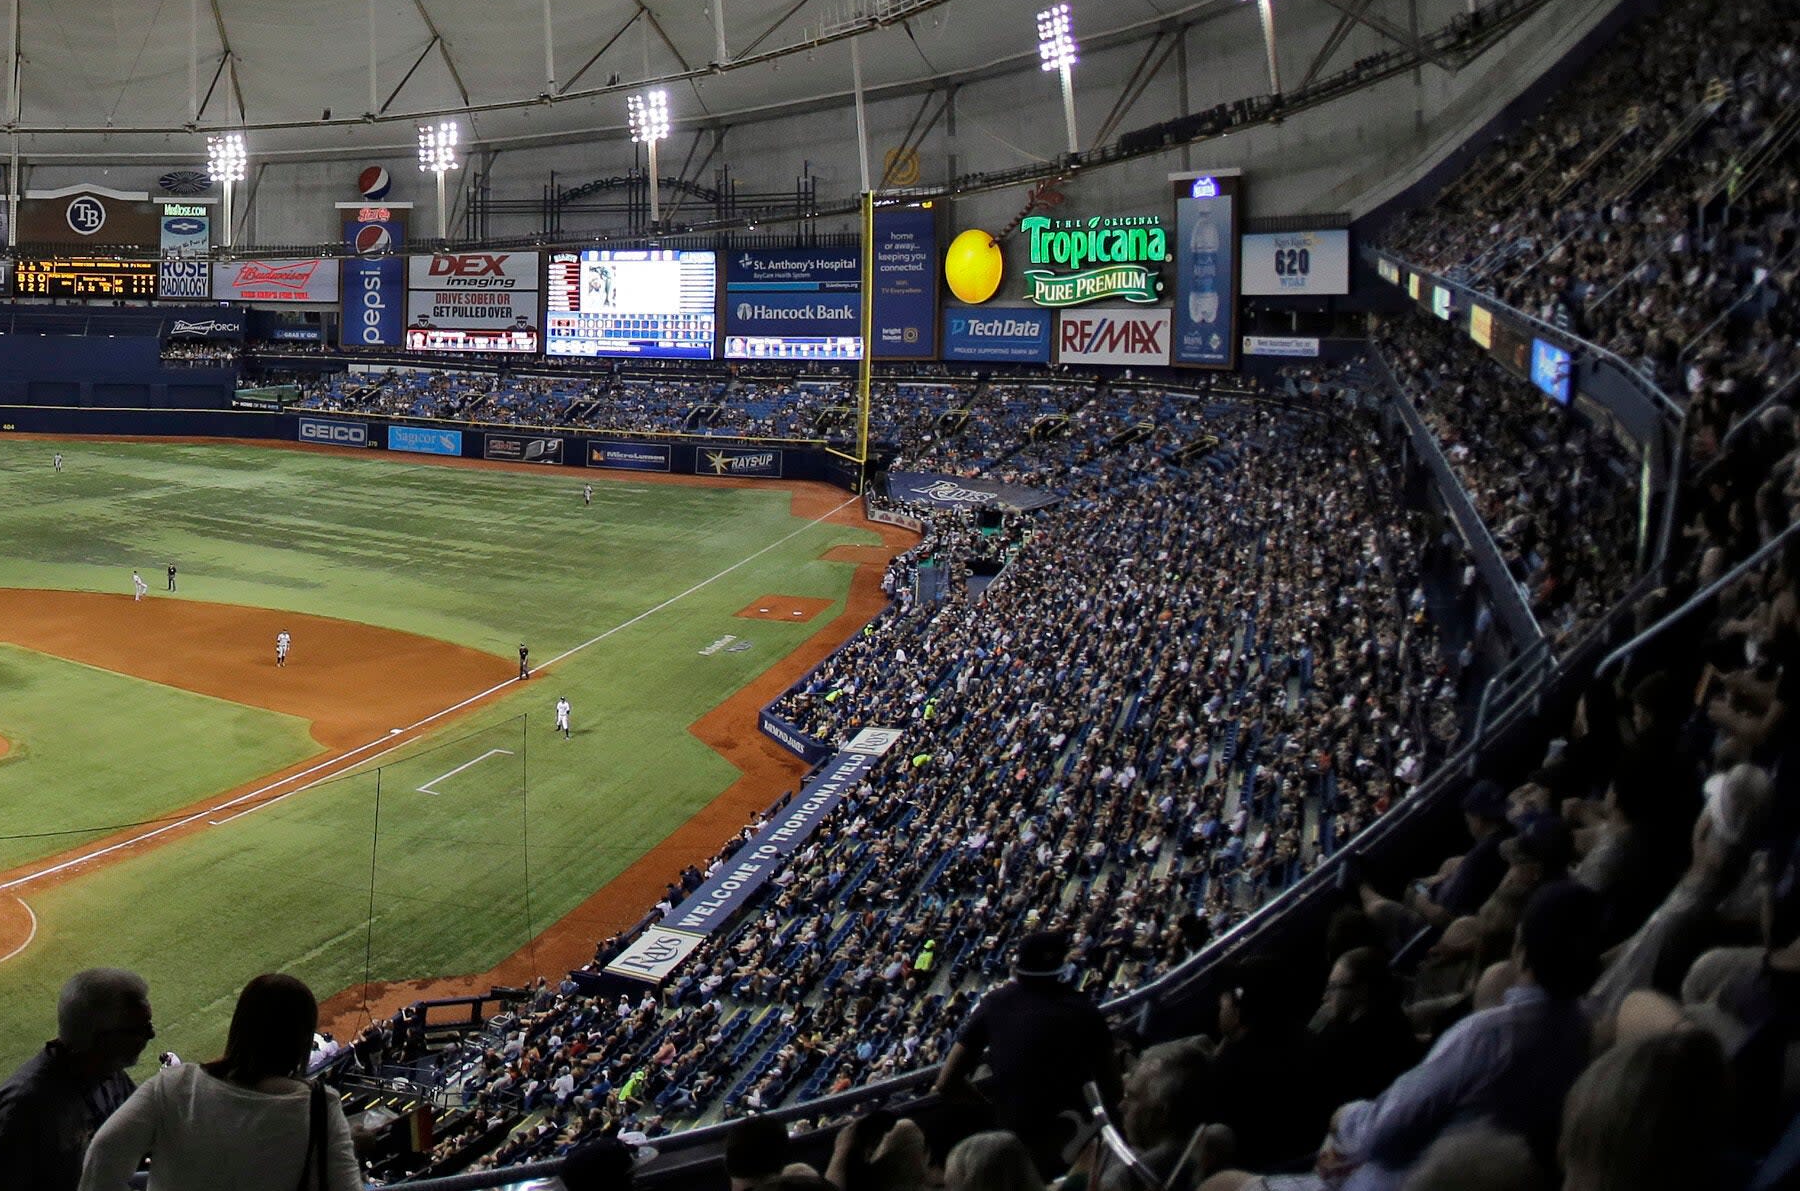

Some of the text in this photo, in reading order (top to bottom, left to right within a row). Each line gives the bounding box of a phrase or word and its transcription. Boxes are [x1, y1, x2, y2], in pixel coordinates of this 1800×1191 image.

[74, 203, 100, 227] TB
[1104, 216, 1160, 227] ORIGINAL
[1055, 220, 1081, 228] THE
[890, 232, 914, 241] home
[1021, 216, 1167, 270] Tropicana
[429, 254, 510, 276] DEX
[754, 258, 856, 272] St. Anthony's Hospital
[878, 252, 926, 263] keeping you
[1275, 248, 1310, 276] 620
[161, 262, 207, 277] ROSE
[241, 267, 311, 281] Budweiser
[880, 263, 924, 272] connected.
[18, 274, 46, 282] B S O
[446, 276, 516, 288] imaging
[161, 278, 207, 296] RADIOLOGY
[1035, 272, 1146, 301] PURE PREMIUM
[435, 293, 510, 305] DRIVE SOBER OR
[360, 270, 386, 344] pepsi
[433, 306, 512, 319] GET PULLED OVER
[754, 305, 854, 320] Hancock Bank
[210, 323, 239, 332] PORCH
[1061, 318, 1163, 354] RE/MAX
[301, 423, 365, 442] GEICO
[395, 429, 437, 445] Sagicor
[759, 453, 773, 465] UP
[787, 737, 805, 754] JAMES
[678, 754, 867, 927] WELCOME TO TROPICANA FIELD
